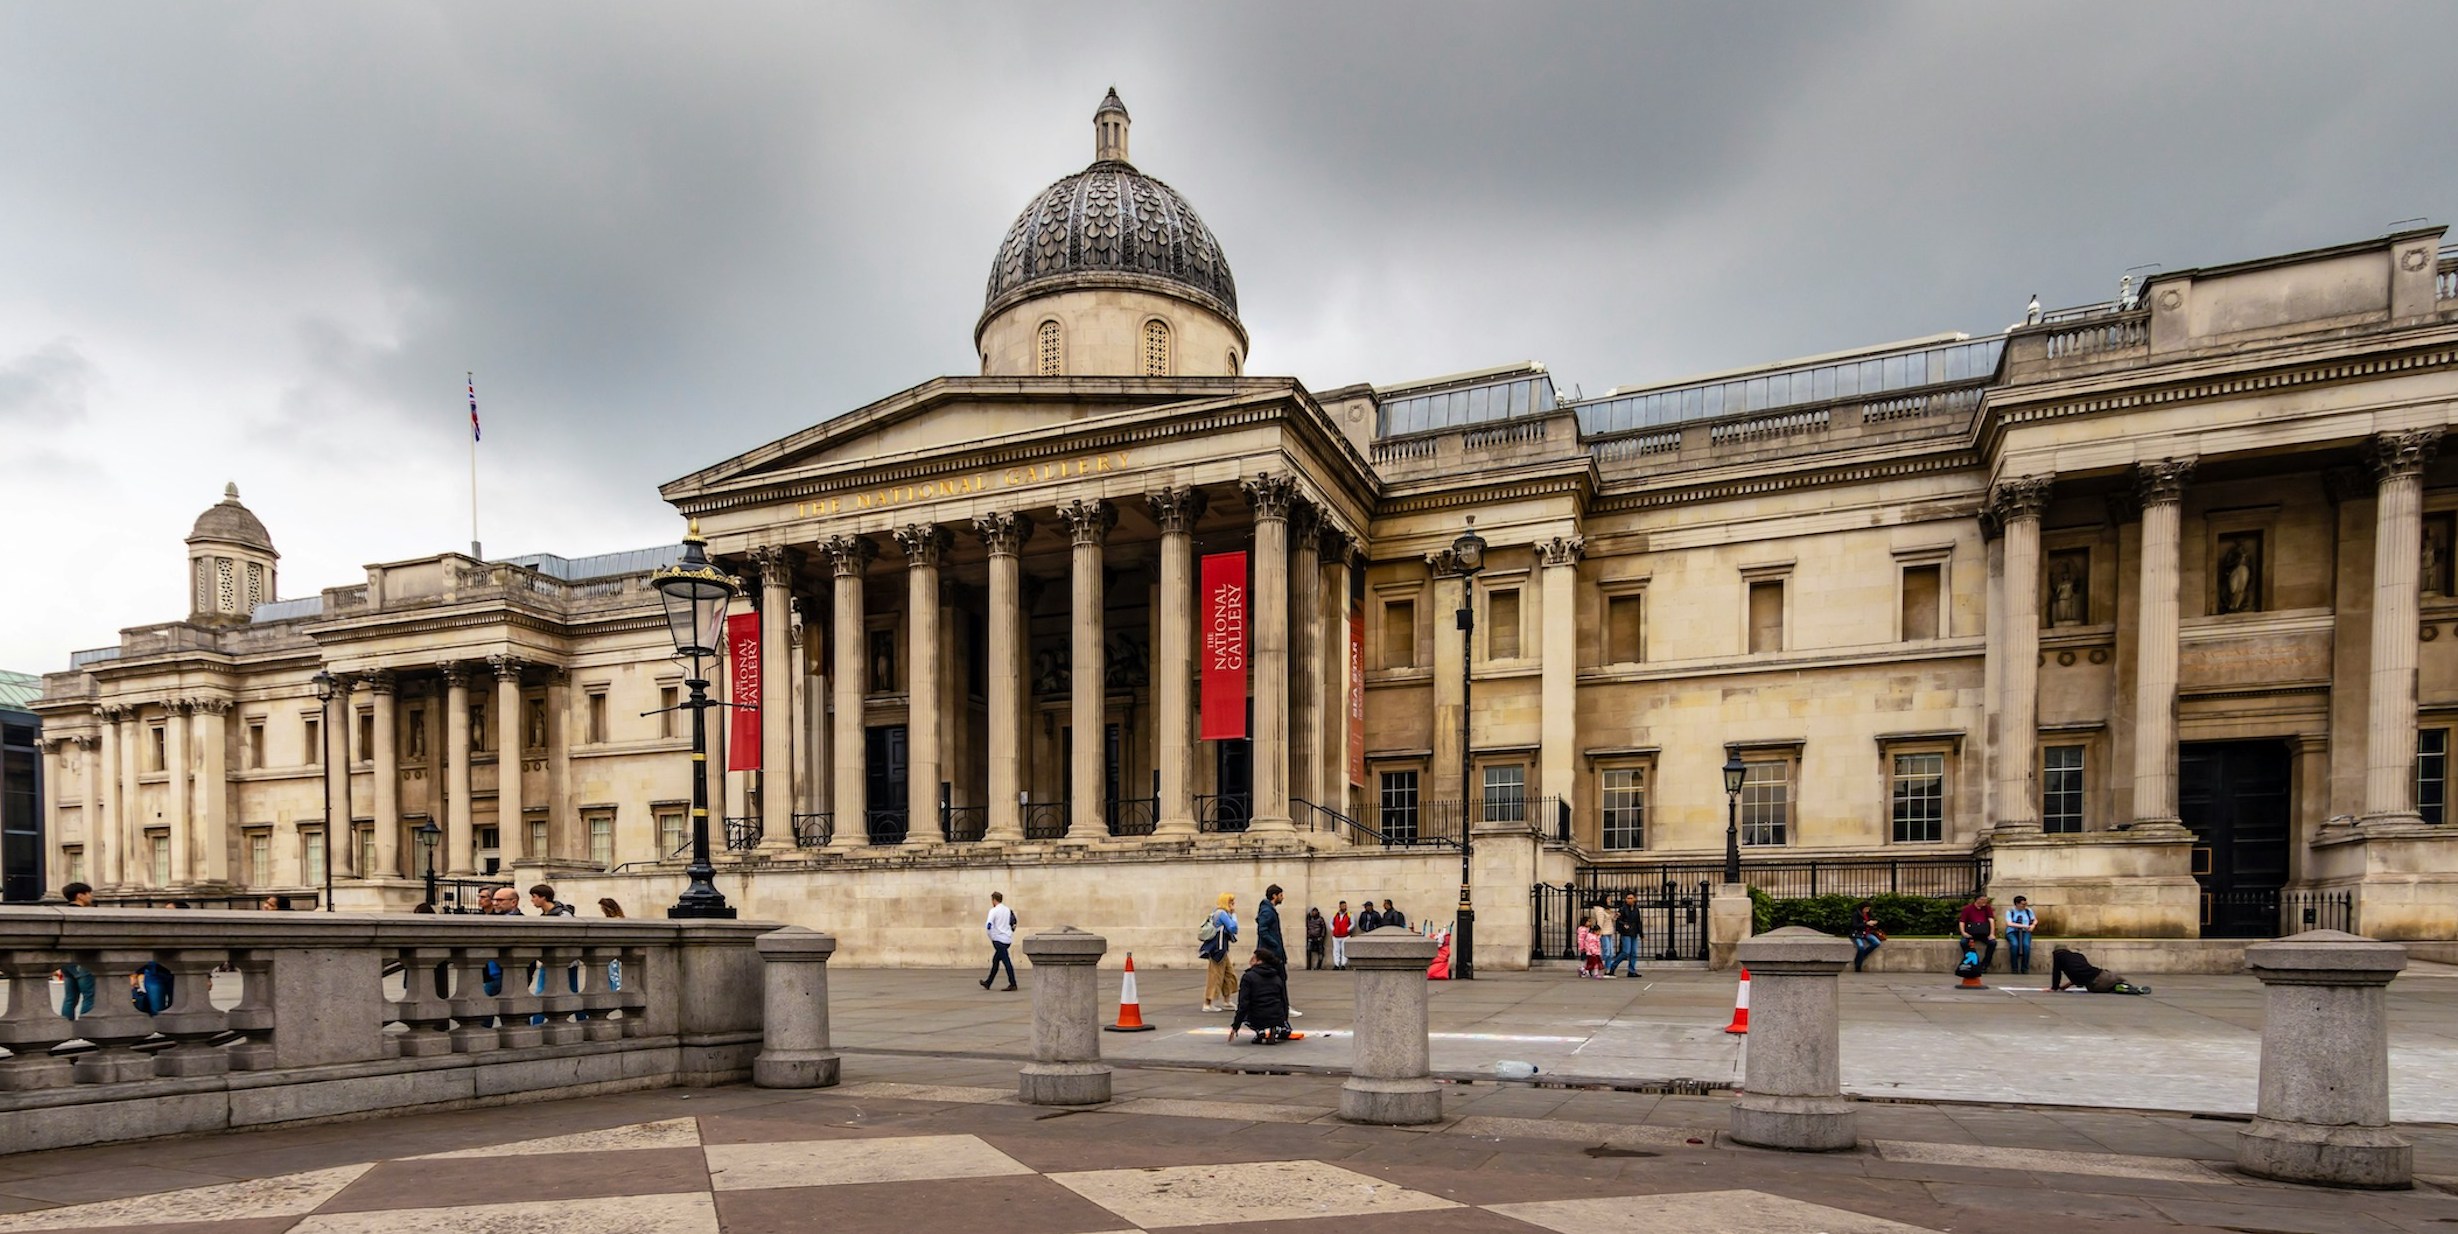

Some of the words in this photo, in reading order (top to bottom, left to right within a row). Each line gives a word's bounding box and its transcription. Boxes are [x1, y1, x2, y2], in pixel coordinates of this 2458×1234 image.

[798, 498, 840, 518] THE
[857, 474, 987, 508] NATIONAL
[1005, 452, 1131, 485] GALLERY
[1214, 584, 1227, 670] NATIONAL
[1228, 584, 1242, 670] GALLERY
[739, 638, 749, 713] NATIONAL
